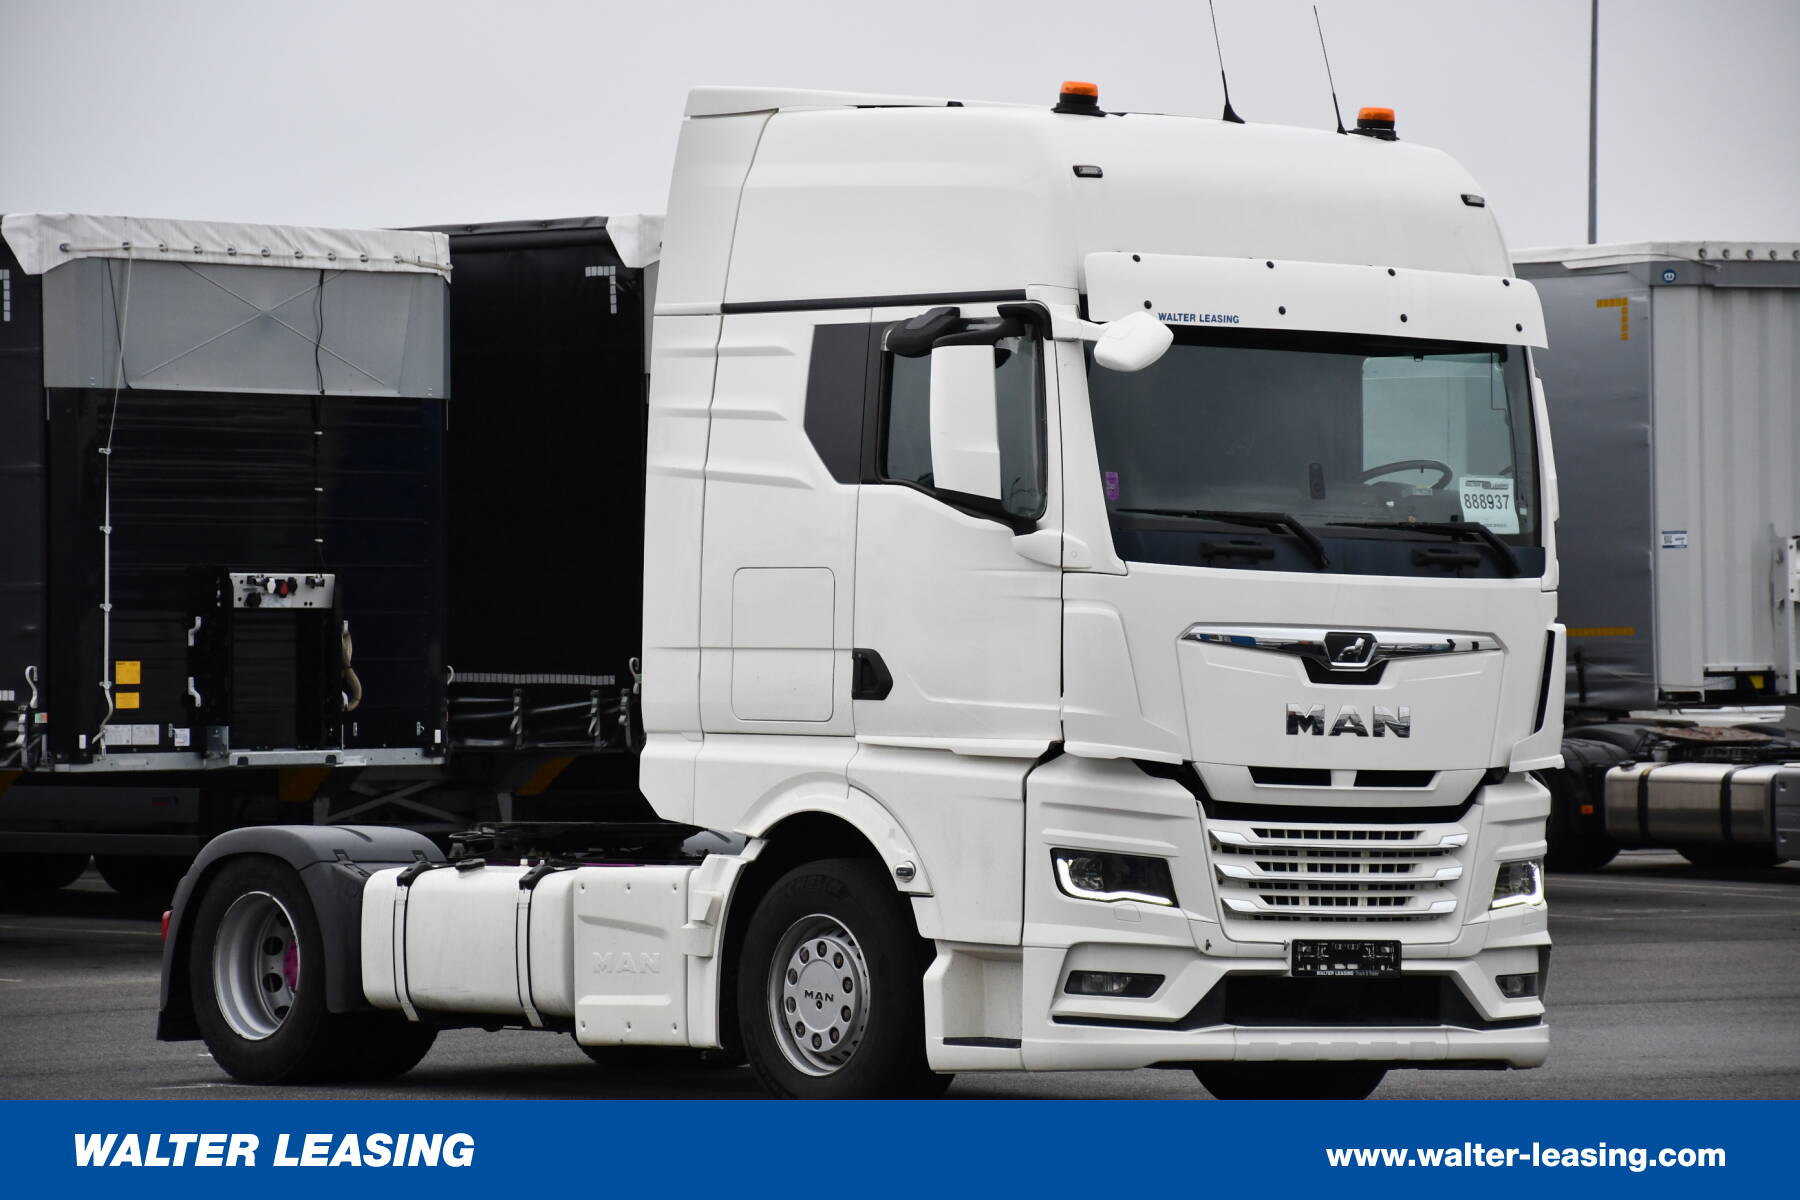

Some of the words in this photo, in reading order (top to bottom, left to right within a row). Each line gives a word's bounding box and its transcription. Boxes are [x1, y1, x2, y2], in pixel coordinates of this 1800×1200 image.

[1158, 312, 1196, 322] WALTER
[1199, 313, 1240, 324] LEASING
[1464, 493, 1510, 511] 888937
[1286, 703, 1410, 738] MAN
[592, 951, 661, 975] MAN
[804, 988, 835, 1003] MAN
